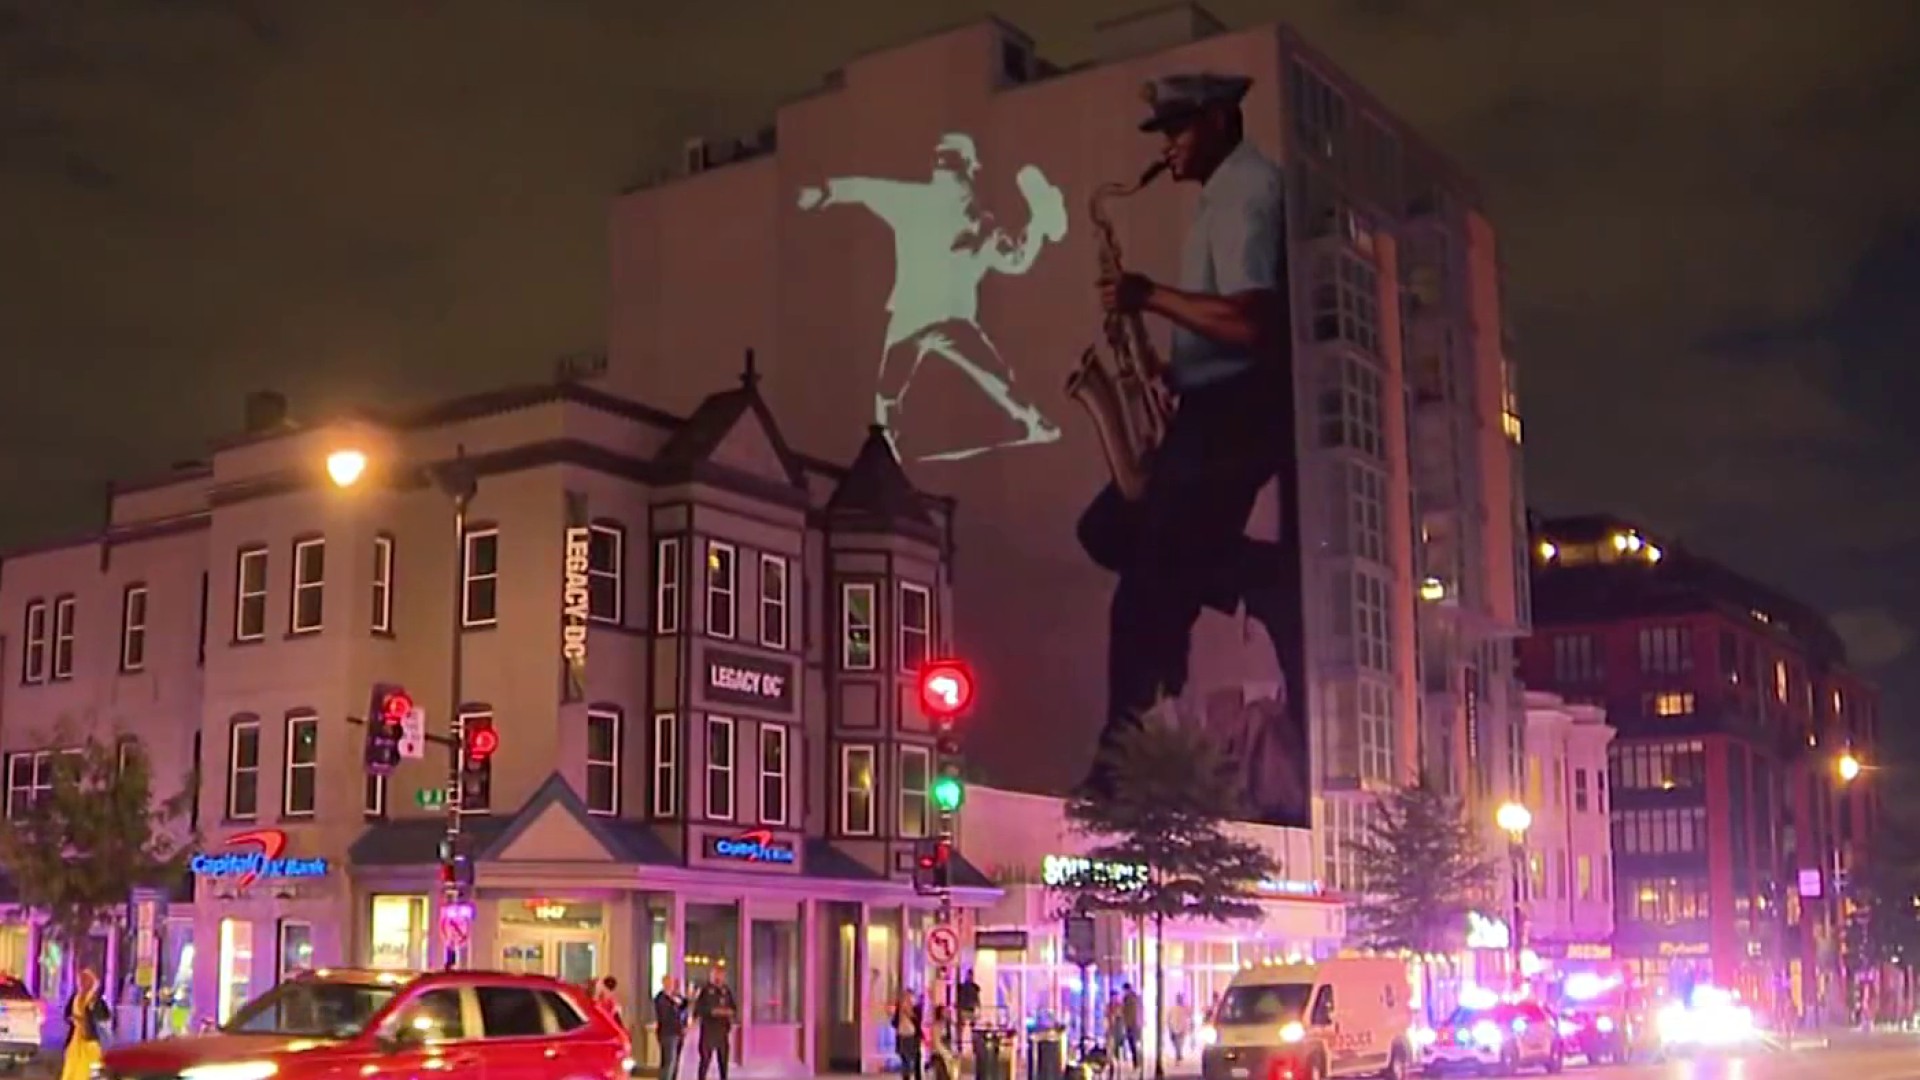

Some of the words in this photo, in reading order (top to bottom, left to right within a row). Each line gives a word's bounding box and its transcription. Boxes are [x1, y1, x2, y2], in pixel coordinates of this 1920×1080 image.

[565, 528, 588, 619] LEGACY
[564, 625, 586, 658] DC
[711, 664, 760, 694] LEGACY
[762, 674, 784, 697] DC
